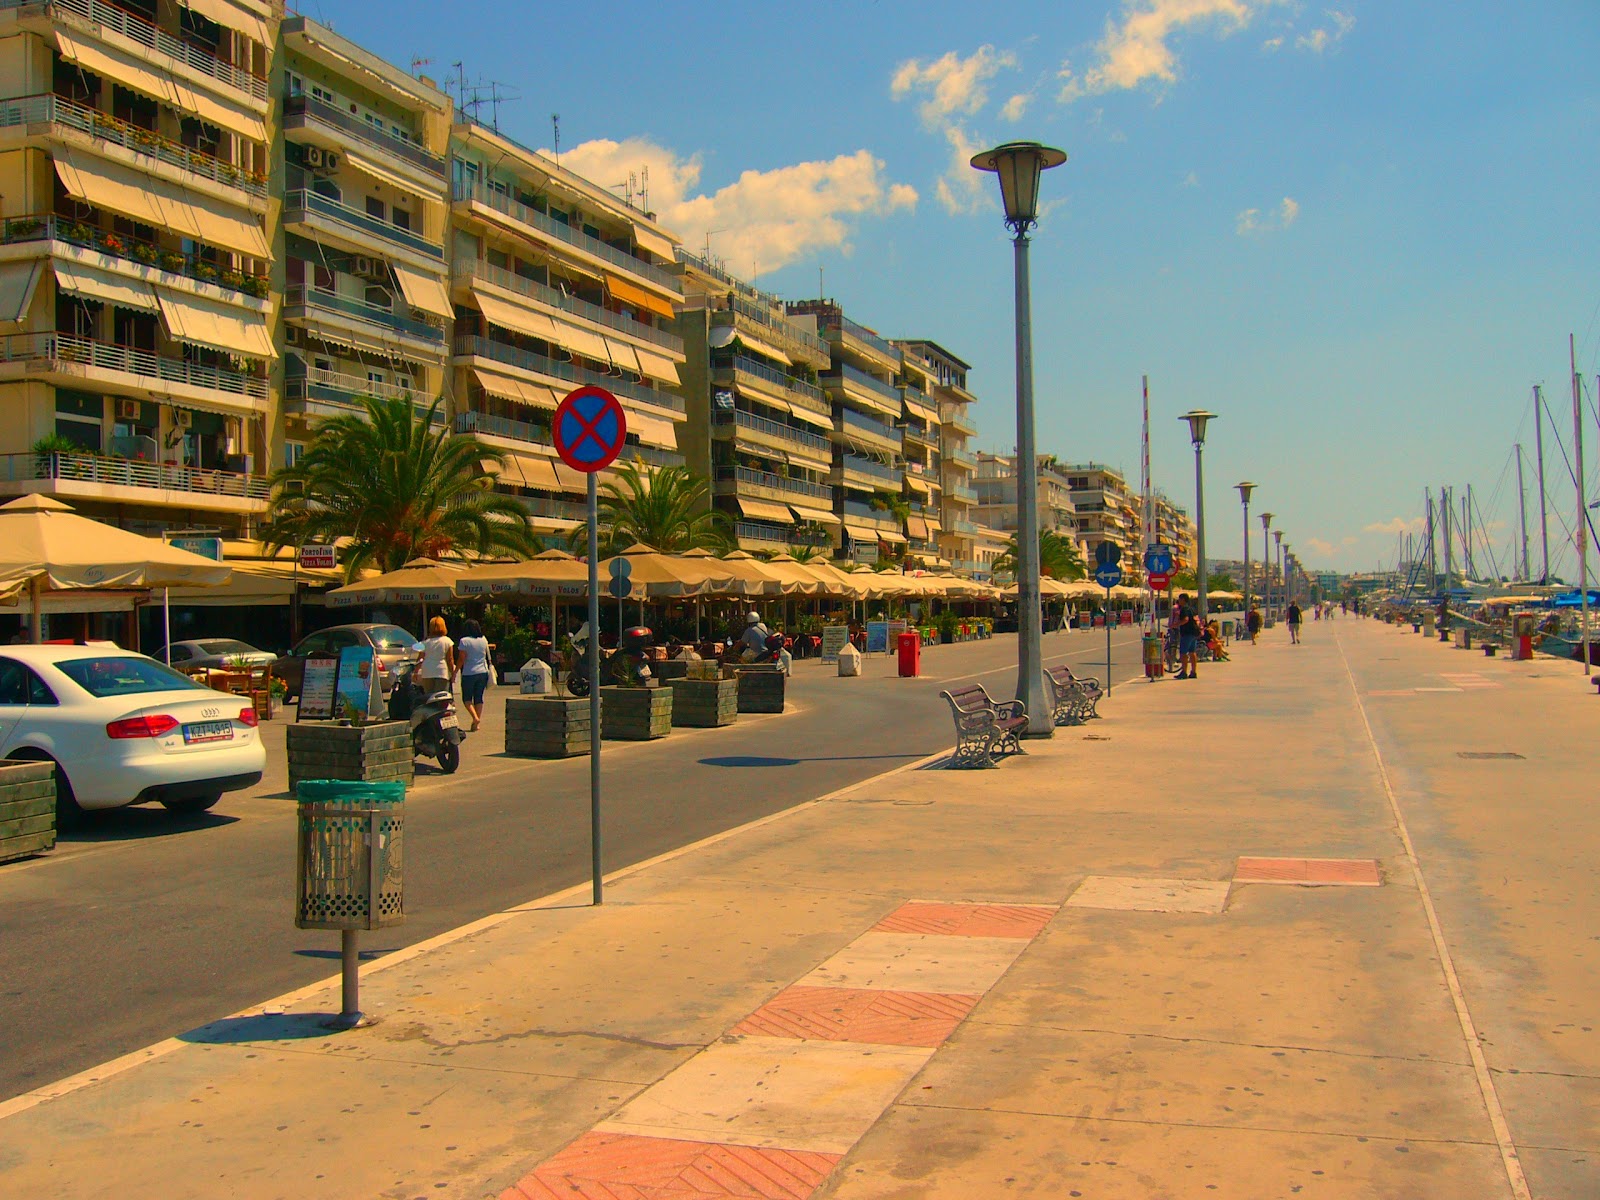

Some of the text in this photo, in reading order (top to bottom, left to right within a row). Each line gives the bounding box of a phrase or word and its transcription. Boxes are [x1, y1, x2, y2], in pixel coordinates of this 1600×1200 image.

[463, 583, 512, 593] PIZZA VOLOS
[530, 584, 579, 594] PIZZA VOLOS
[420, 592, 440, 601] VOLOS
